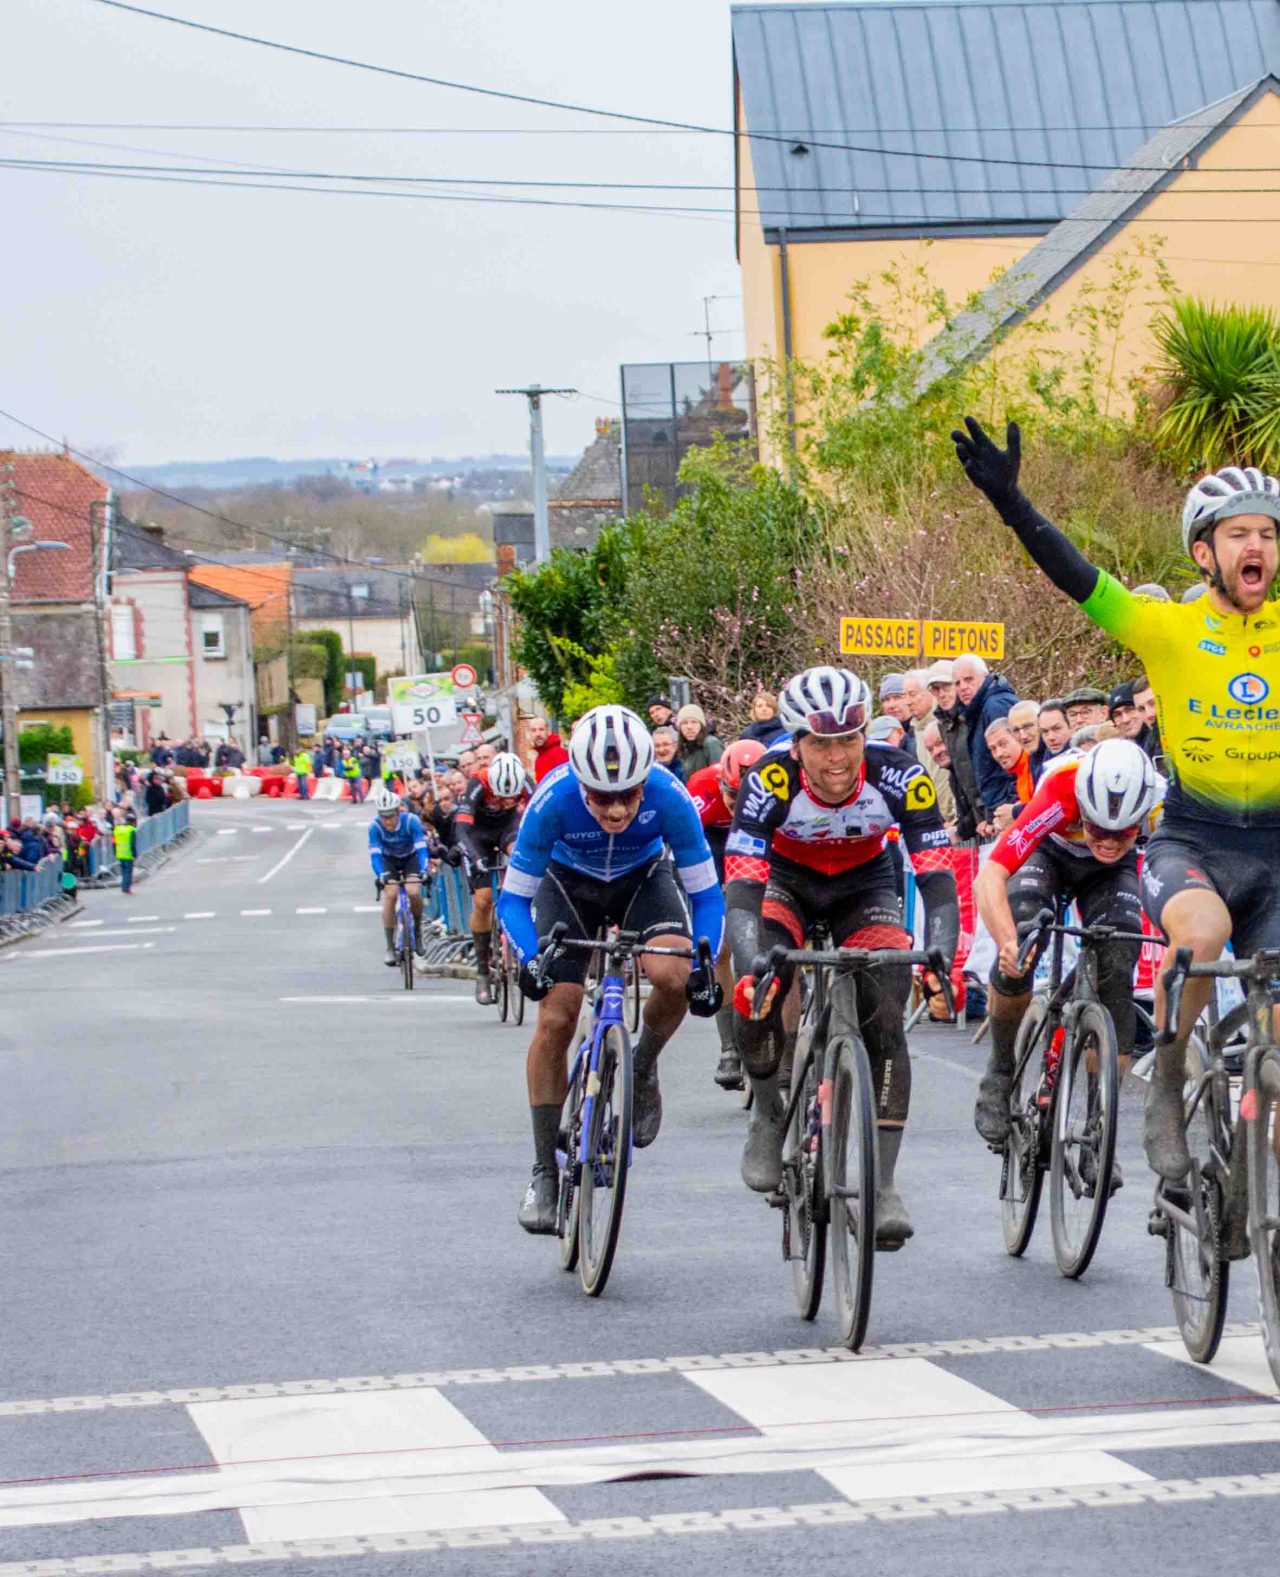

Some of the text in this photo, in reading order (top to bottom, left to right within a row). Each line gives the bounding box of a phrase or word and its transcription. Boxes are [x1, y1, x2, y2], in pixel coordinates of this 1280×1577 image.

[845, 624, 999, 652] PASSAGE PIETONS
[413, 707, 440, 725] 50
[54, 771, 77, 782] 150
[564, 831, 600, 840] GUYOT
